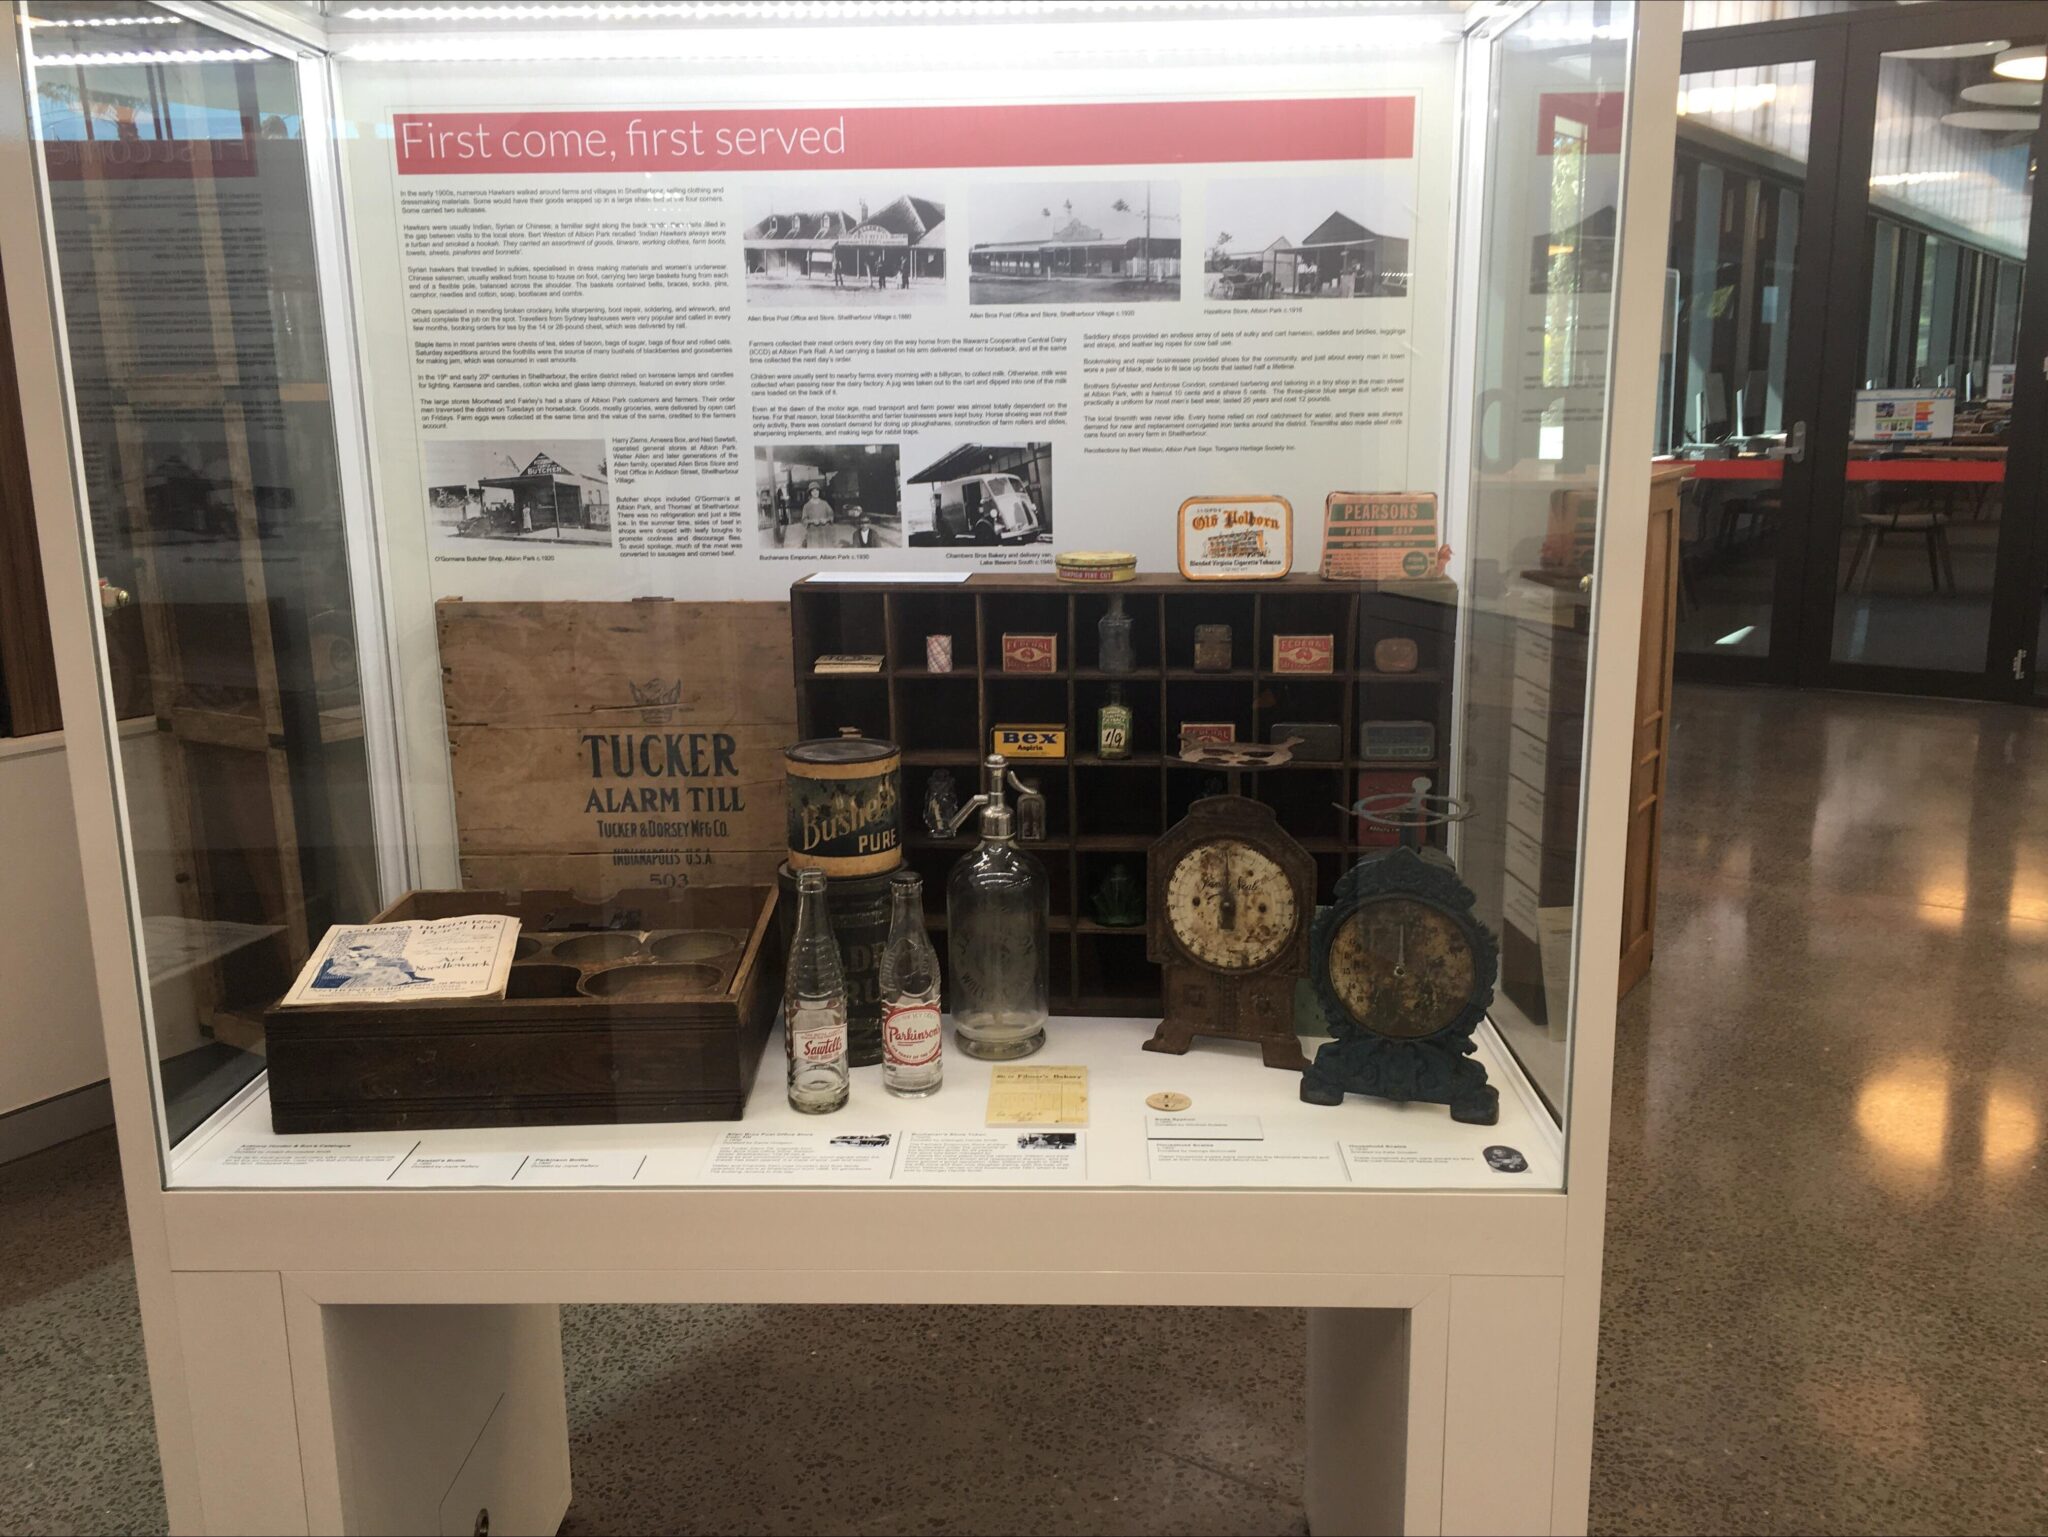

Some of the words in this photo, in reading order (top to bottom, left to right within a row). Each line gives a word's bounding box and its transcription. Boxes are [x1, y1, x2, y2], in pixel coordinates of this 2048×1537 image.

[402, 122, 492, 159] First
[502, 129, 617, 162] come,
[626, 118, 704, 156] first
[716, 116, 846, 155] served
[1192, 514, 1218, 531] Old
[1223, 510, 1280, 530] Holborn
[1344, 504, 1418, 519] PEARSONS
[1280, 640, 1328, 650] FEDERAL
[1002, 732, 1057, 744] Bex
[582, 734, 739, 778] TUCKER
[584, 787, 680, 813] ALARM
[686, 786, 746, 812] TILL
[597, 820, 636, 838] TUCKER
[648, 820, 689, 838] DORSEY
[858, 828, 896, 853] PURE
[613, 848, 680, 866] INDIANAPOLIS
[650, 874, 689, 888] 503
